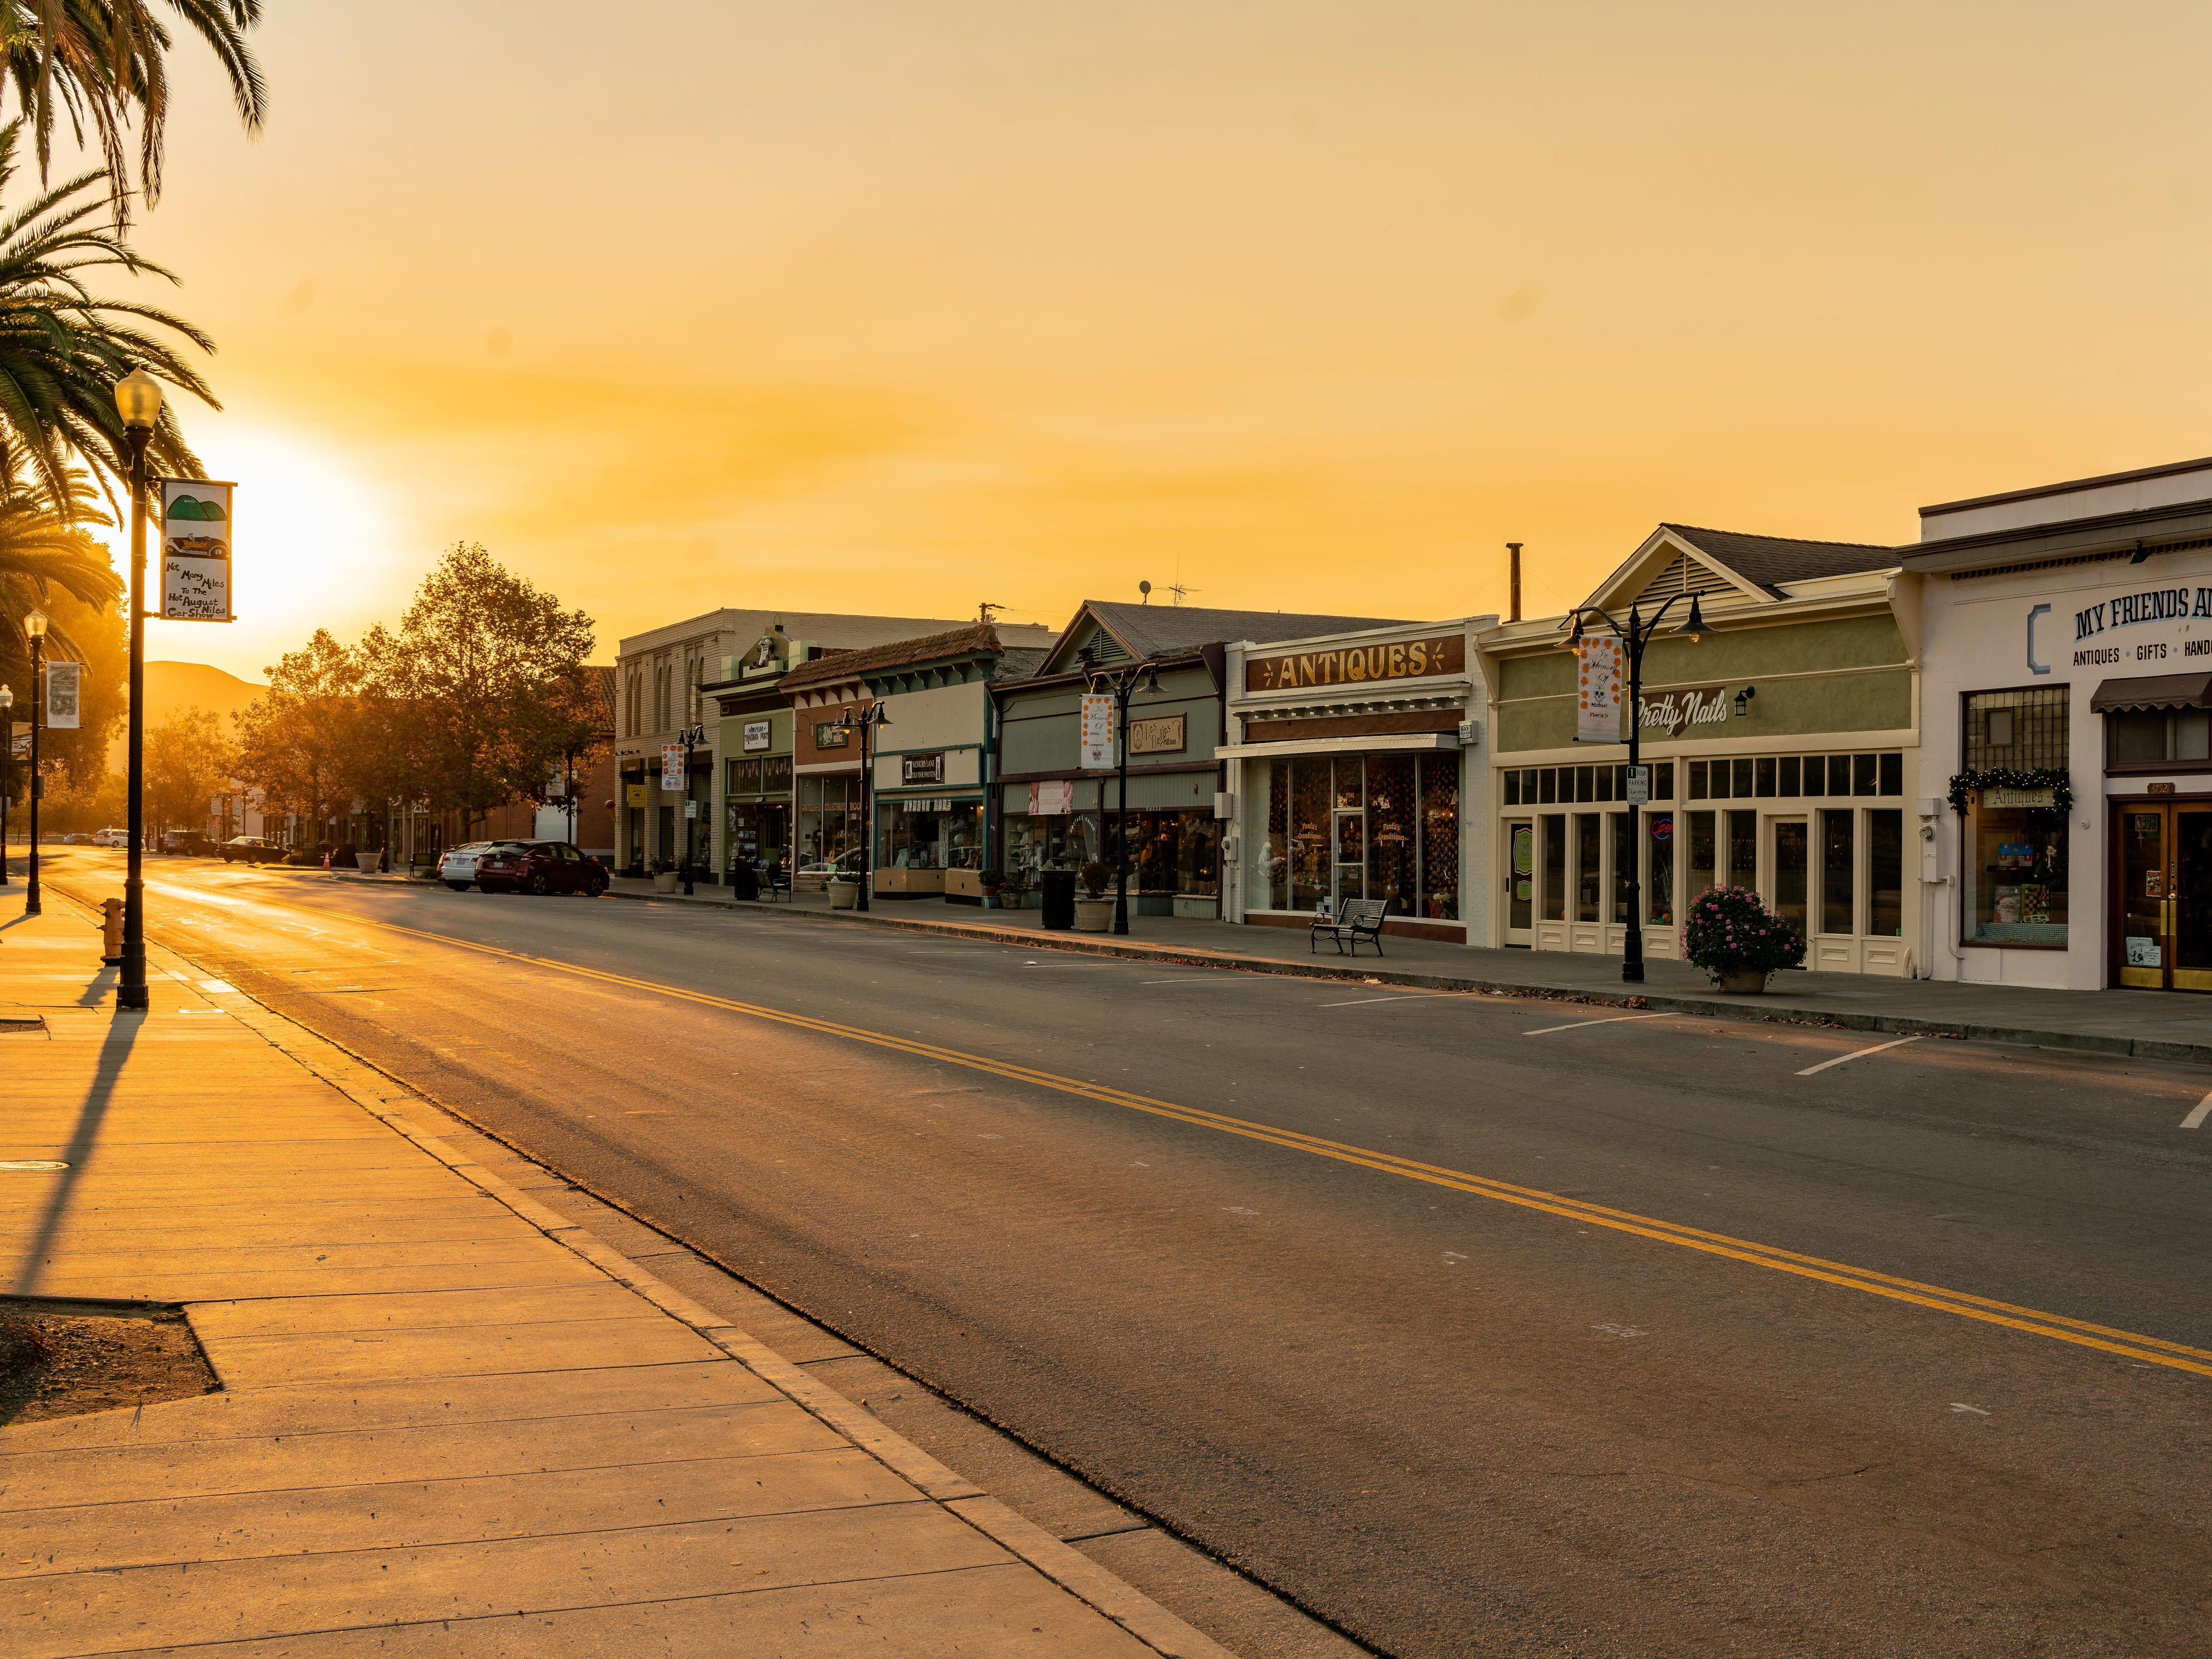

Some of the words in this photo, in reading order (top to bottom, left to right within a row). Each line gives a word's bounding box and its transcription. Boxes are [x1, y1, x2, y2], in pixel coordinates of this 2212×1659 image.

[166, 562, 180, 572] Not
[181, 570, 203, 581] Many
[201, 578, 224, 589] Miles
[168, 593, 183, 601] Hot
[182, 596, 219, 608] August
[2074, 602, 2105, 643] MY
[2109, 588, 2189, 629] FRIENDS
[1596, 649, 1608, 658] In
[2073, 648, 2119, 666] ANTIQUES
[2137, 644, 2167, 660] GIFTS
[2185, 640, 2212, 657] HAND
[1278, 642, 1427, 688] ANTIQUES
[1586, 658, 1617, 674] Memory
[1598, 673, 1609, 684] Of
[51, 667, 76, 715] NILES
[1681, 689, 1727, 726] Nails
[1086, 713, 1110, 722] Memory
[1095, 722, 1103, 731] Of
[1144, 722, 1156, 741] Les
[1630, 769, 1633, 777] 1
[2152, 783, 2171, 794] 37521
[1993, 789, 2043, 807] Antiques
[802, 803, 821, 812] ANTIQUES
[825, 803, 846, 811] COLLECTIBLES
[850, 802, 868, 811] BOOS
[934, 800, 951, 811] LANE
[1070, 816, 1083, 833] COTTAGE
[1383, 822, 1400, 831] Paula's
[1651, 821, 1674, 836] Open
[1379, 832, 1405, 842] Grandtiques
